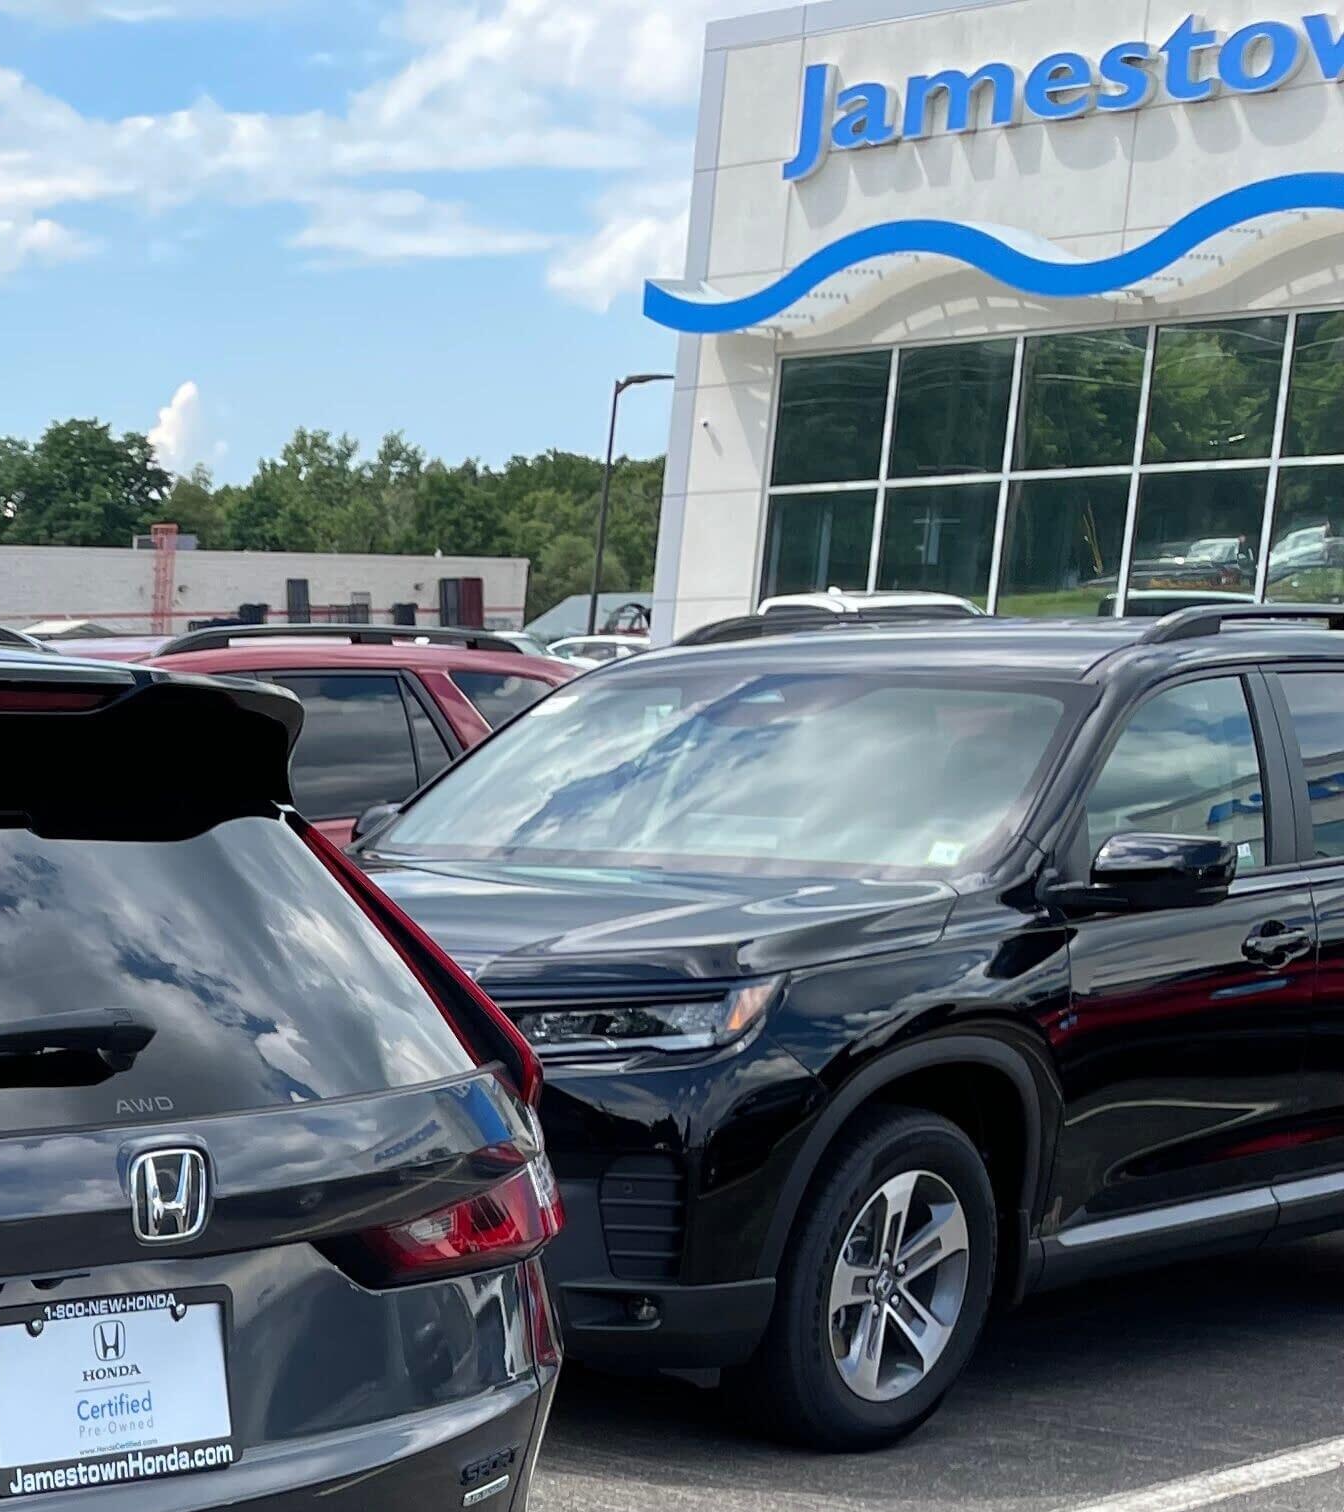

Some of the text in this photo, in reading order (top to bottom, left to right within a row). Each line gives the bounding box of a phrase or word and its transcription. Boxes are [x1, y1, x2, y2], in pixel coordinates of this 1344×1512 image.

[116, 1096, 174, 1114] AWD
[82, 1364, 142, 1382] HONDA
[77, 1389, 152, 1421] Certified
[79, 1417, 154, 1438] Pre-Owned
[9, 1443, 234, 1495] JamestownHonda.com
